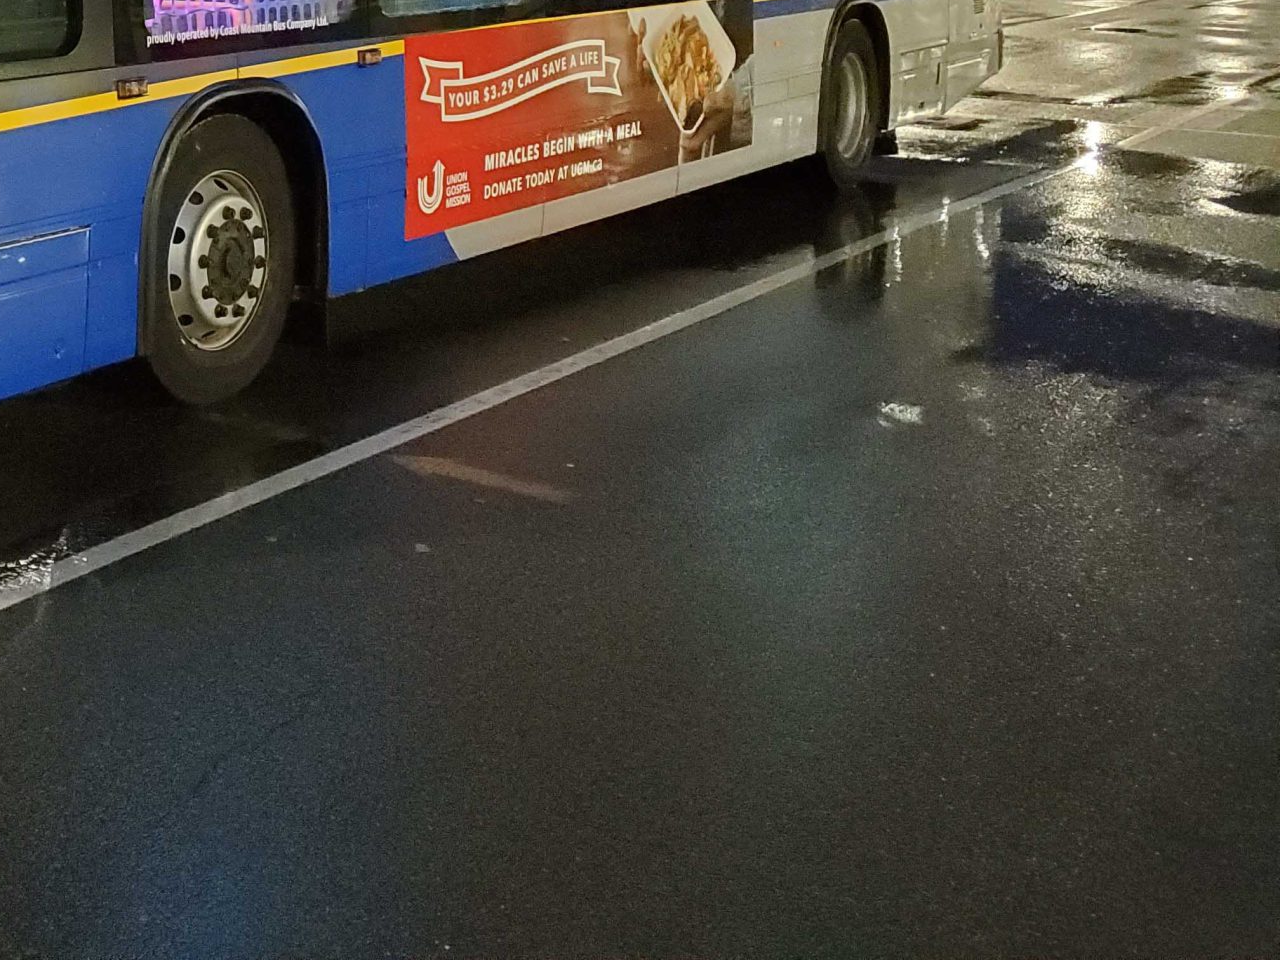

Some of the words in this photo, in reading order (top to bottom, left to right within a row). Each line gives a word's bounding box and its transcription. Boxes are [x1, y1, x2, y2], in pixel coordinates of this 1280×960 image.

[146, 31, 176, 48] proudly
[176, 26, 209, 44] operated
[209, 25, 219, 40] by
[219, 24, 240, 37] Coast
[273, 20, 286, 32] Bus
[286, 18, 316, 31] Company
[316, 15, 329, 27] Ltd.
[448, 89, 481, 109] YOUR
[483, 77, 514, 103] $3.29
[517, 67, 539, 89] CAN
[542, 56, 568, 79] SAVE
[569, 53, 578, 69] A
[579, 51, 599, 67] LIFE
[484, 143, 540, 172] MIRACLES
[543, 135, 575, 158] BEGIN
[577, 128, 604, 150] WITH
[606, 126, 614, 143] A
[616, 120, 643, 141] MEAL
[445, 181, 471, 197] GOSPEL
[446, 170, 468, 186] UNION
[483, 176, 523, 201] DONATE
[525, 168, 556, 190] TODAY
[557, 165, 569, 181] AT
[570, 158, 603, 178] UGM.ca
[445, 193, 471, 209] MISSION
